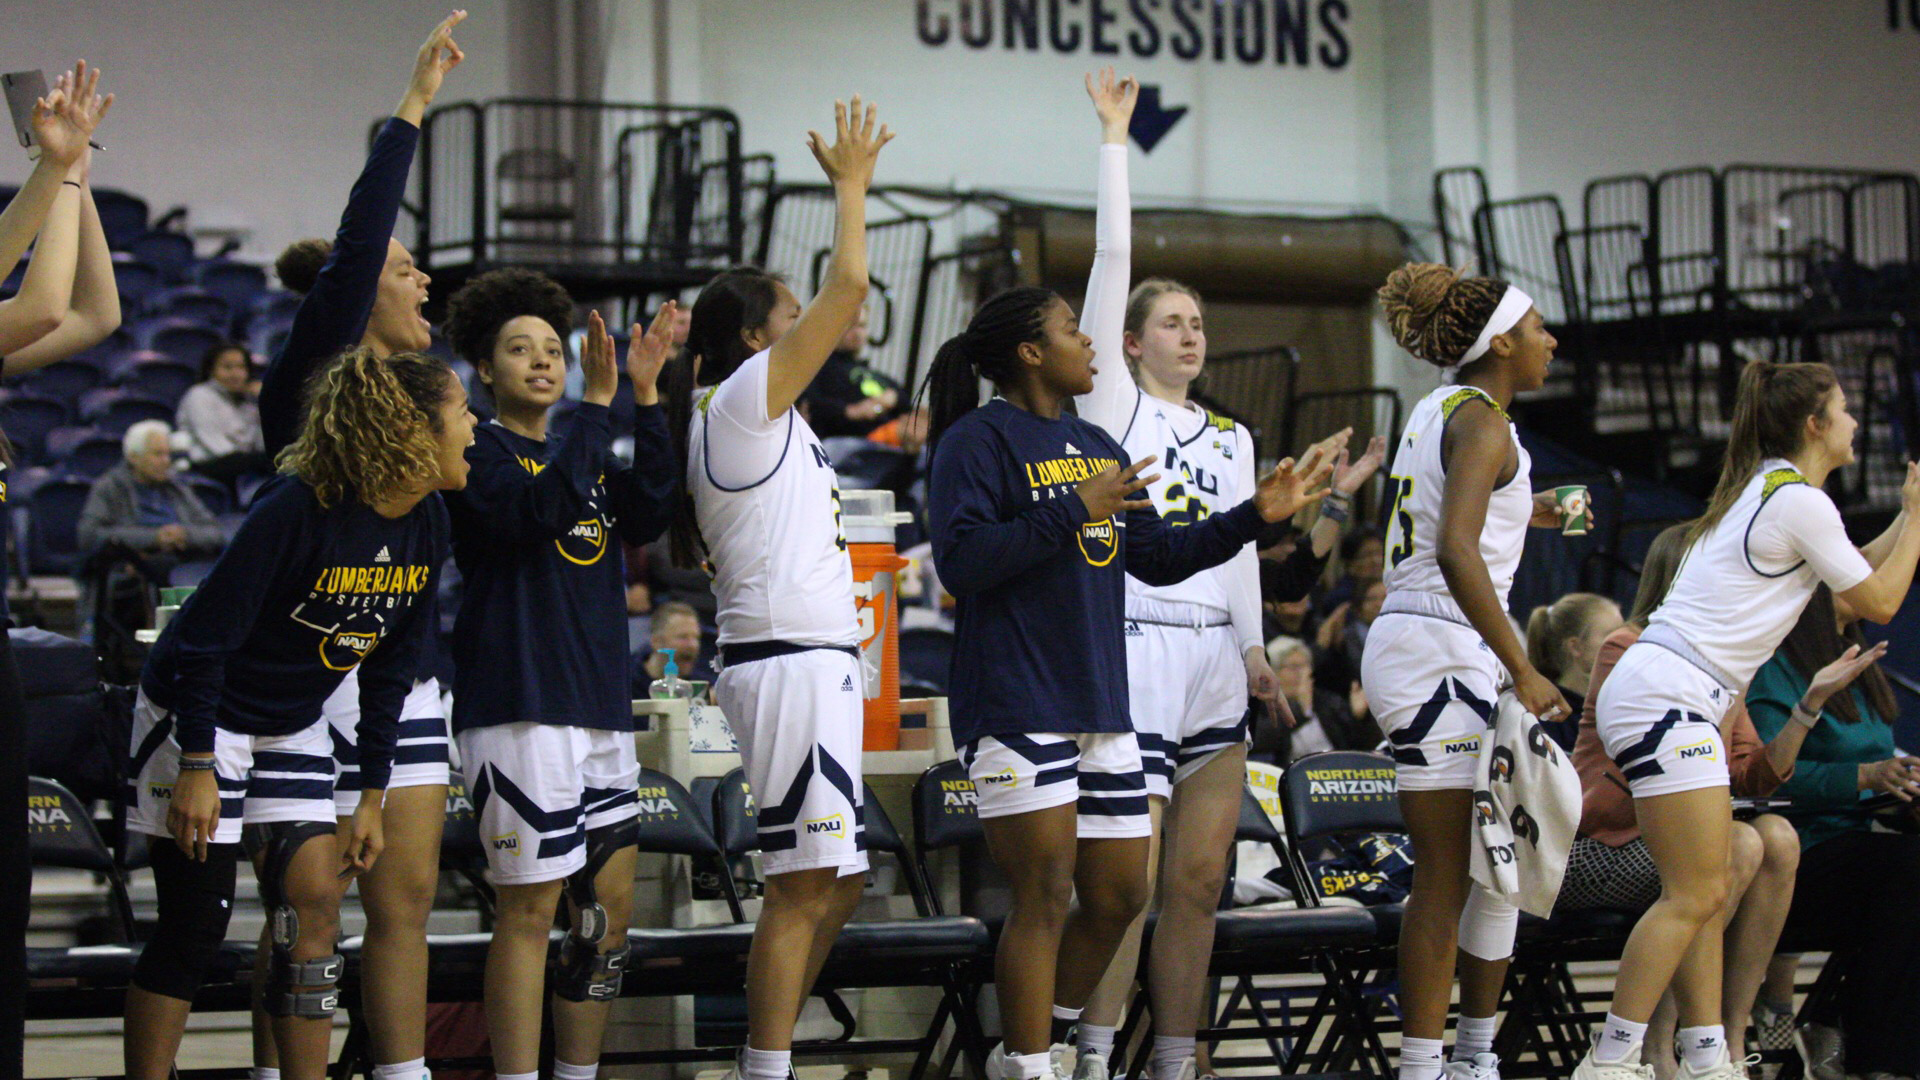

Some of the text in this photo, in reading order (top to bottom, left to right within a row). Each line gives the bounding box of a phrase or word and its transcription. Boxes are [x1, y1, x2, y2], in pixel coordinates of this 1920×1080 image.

[916, 0, 1350, 69] CONCESSIONS
[1025, 457, 1120, 488] LUMBERJA
[1084, 526, 1110, 538] NAU
[314, 564, 430, 595] LUMBERJAKS
[337, 635, 373, 651] NAU
[1445, 741, 1479, 754] NAU
[1680, 744, 1712, 759] NAU
[152, 786, 172, 799] NA
[807, 820, 841, 833] NAU
